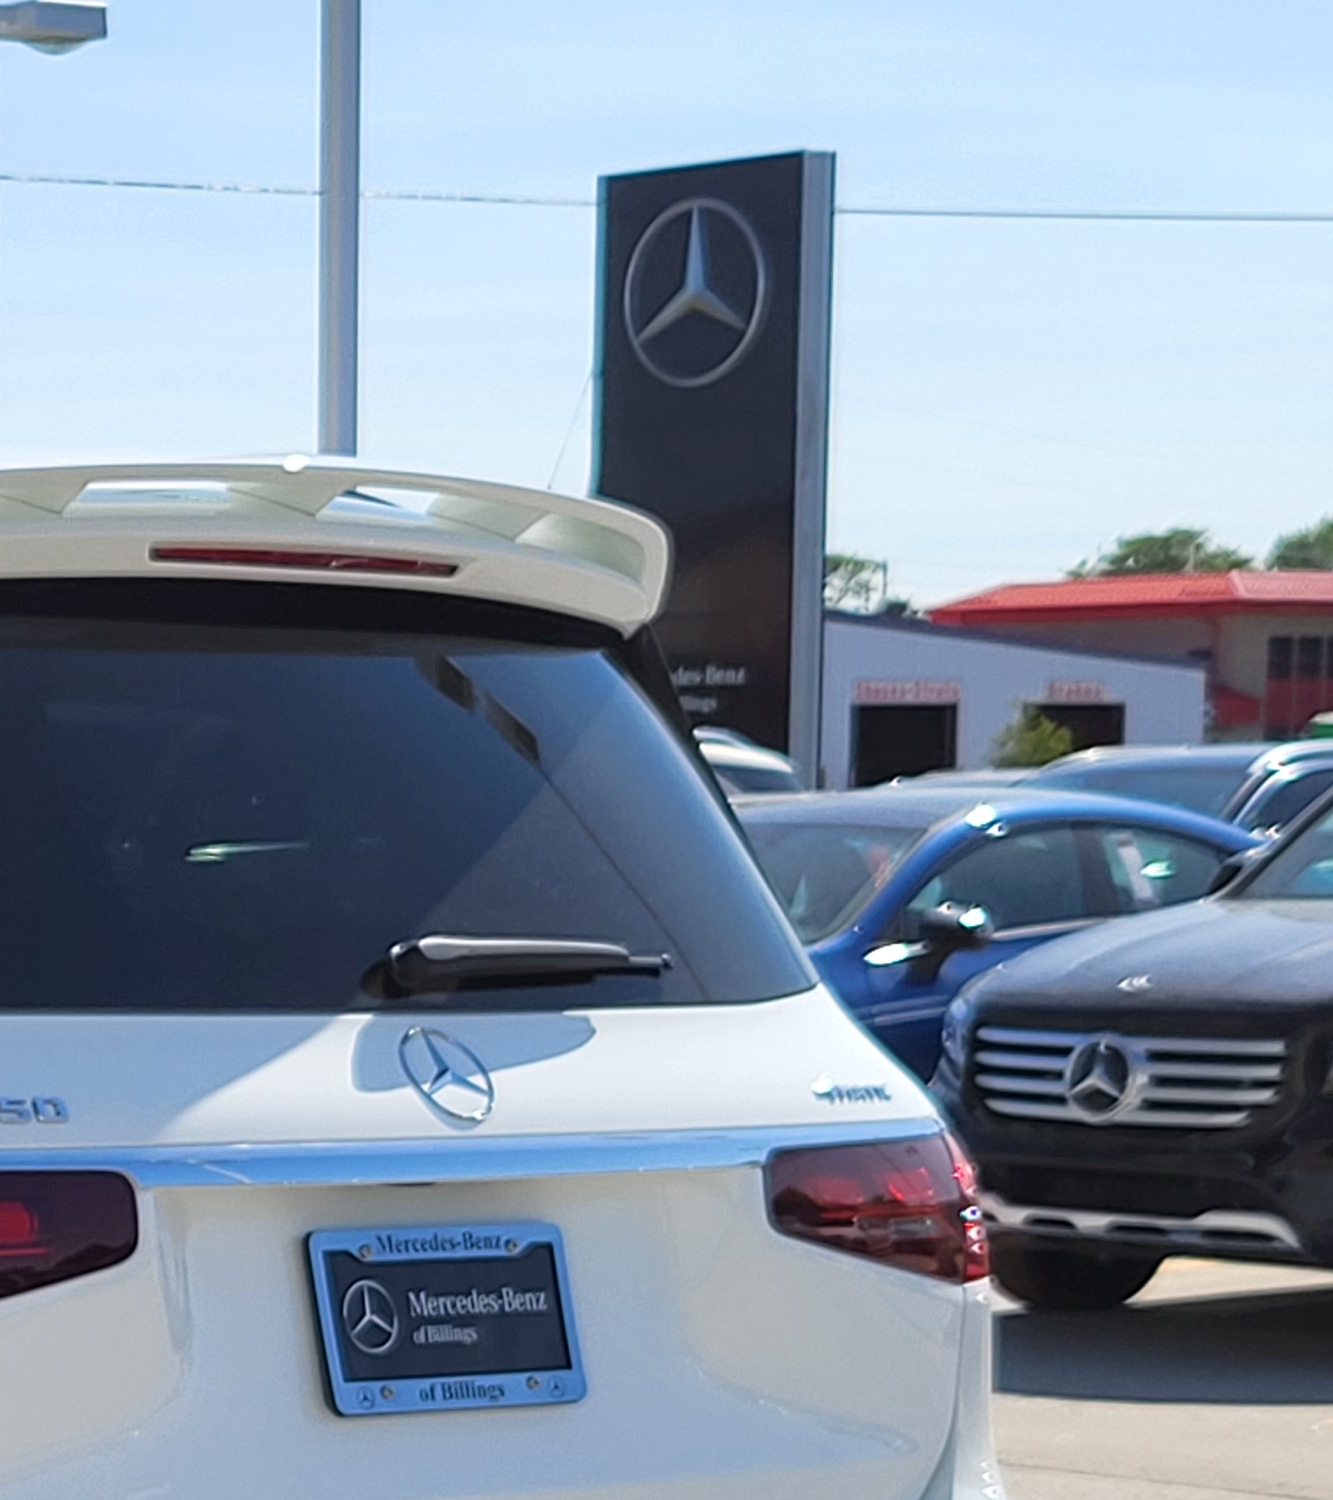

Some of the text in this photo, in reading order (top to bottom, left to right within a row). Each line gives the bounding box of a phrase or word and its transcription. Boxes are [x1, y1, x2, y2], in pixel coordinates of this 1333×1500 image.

[376, 1231, 502, 1254] Mercedes-Benz
[407, 1287, 548, 1317] Mercedes-Benz
[413, 1324, 479, 1344] of Billings
[419, 1380, 505, 1402] of Billings
